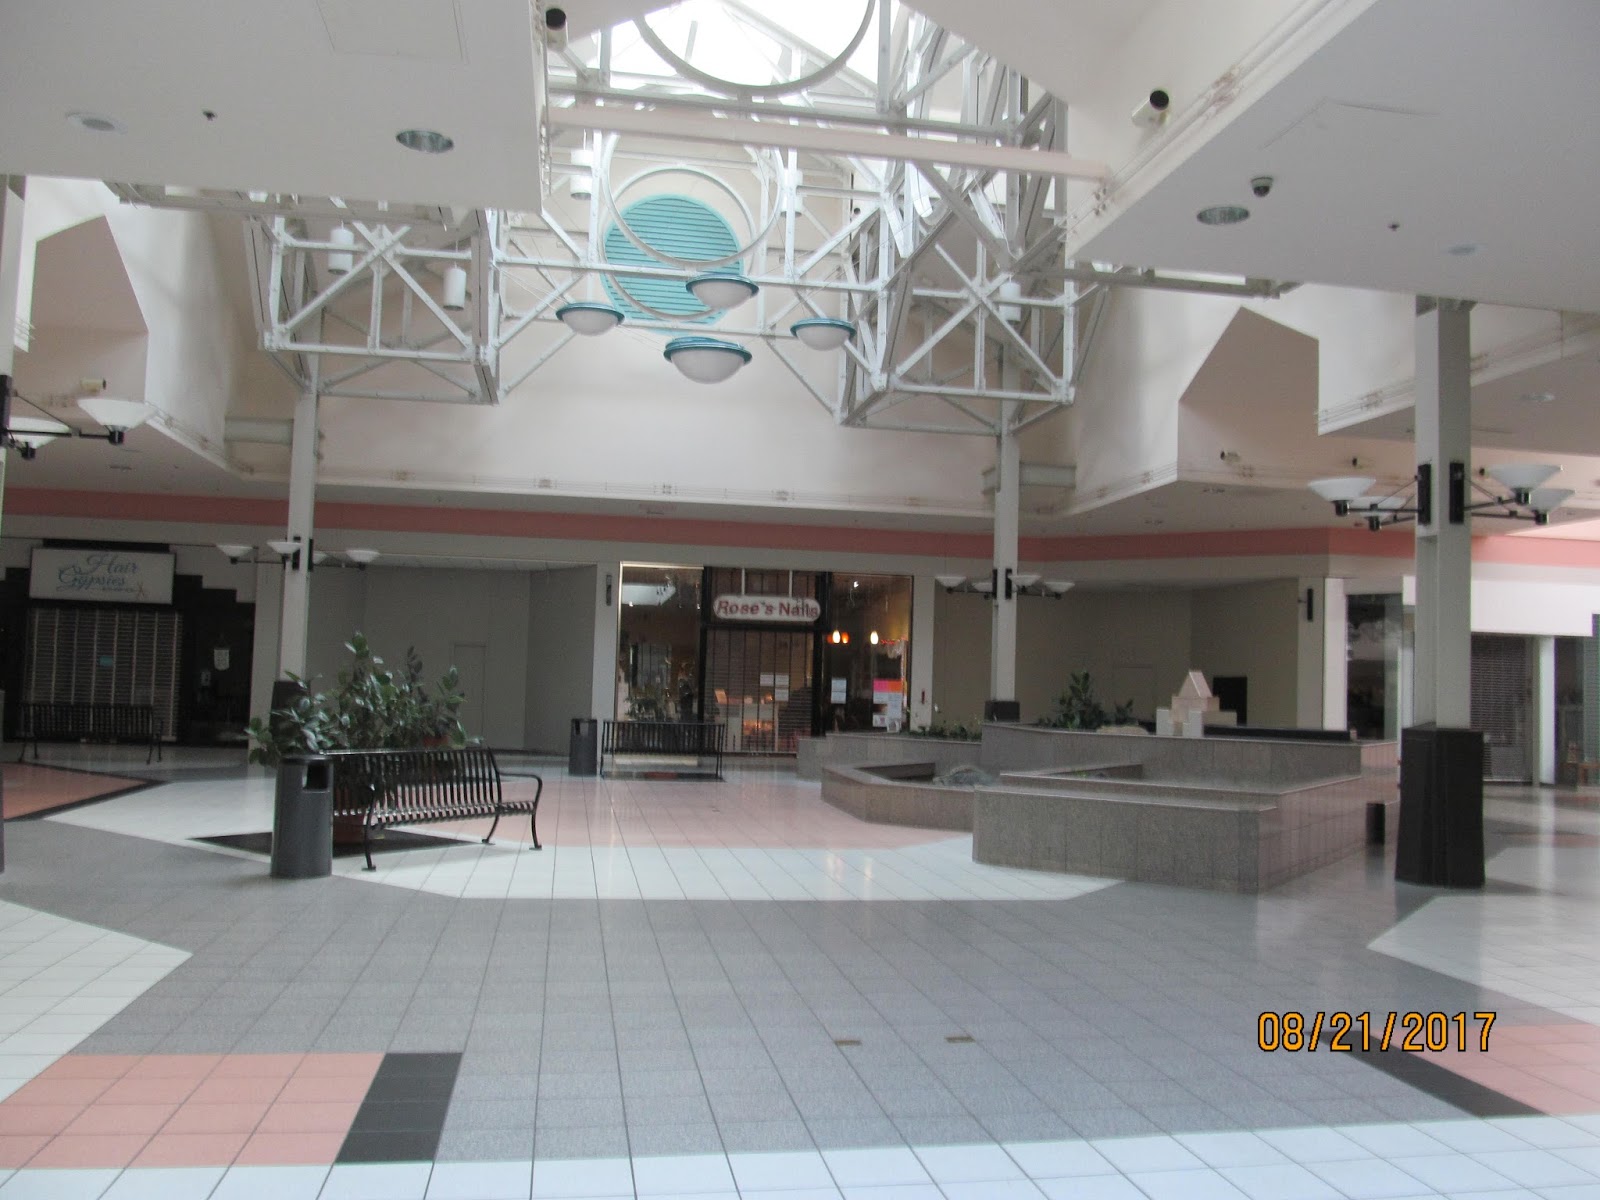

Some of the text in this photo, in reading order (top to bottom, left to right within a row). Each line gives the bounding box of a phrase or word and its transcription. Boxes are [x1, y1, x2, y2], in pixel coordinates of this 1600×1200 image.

[86, 554, 138, 574] Hair
[717, 600, 819, 618] Rose's Nails
